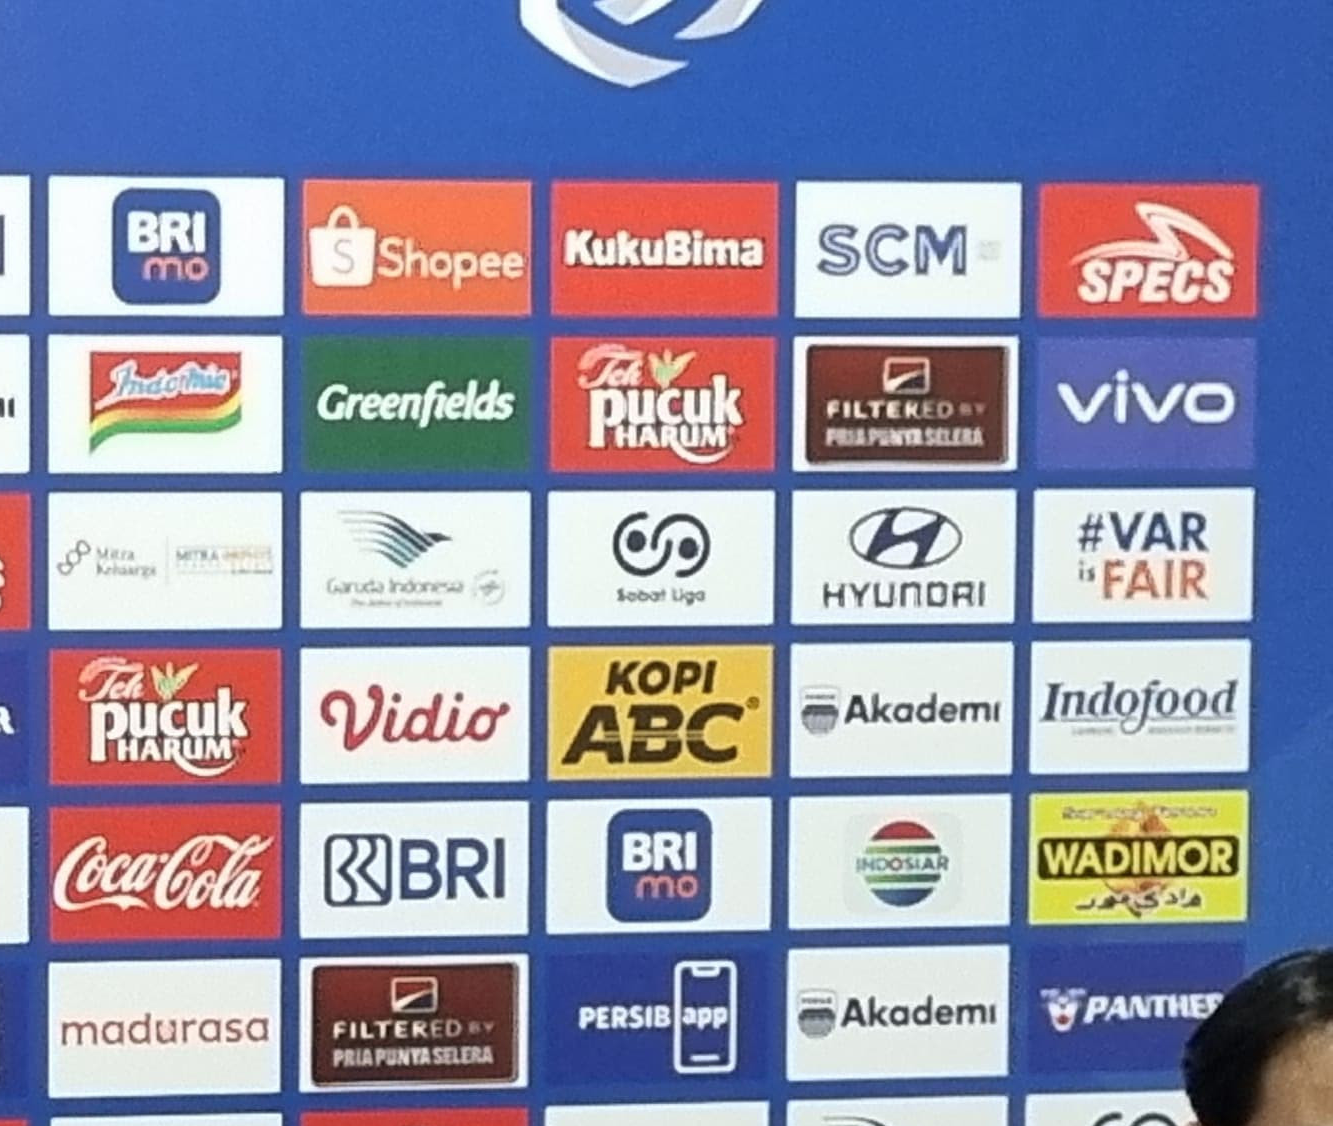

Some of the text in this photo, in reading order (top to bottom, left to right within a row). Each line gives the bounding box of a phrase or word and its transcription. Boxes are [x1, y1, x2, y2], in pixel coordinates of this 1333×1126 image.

[128, 211, 206, 252] BRI
[564, 229, 763, 268] KukuBima
[819, 225, 967, 276] SCM
[143, 257, 208, 281] mo
[376, 236, 522, 290] Shopee
[1079, 260, 1234, 303] SPECS
[317, 380, 515, 429] Greenfields
[589, 376, 742, 448] pucuk
[1058, 371, 1235, 424] vivo
[617, 426, 728, 448] HARUM
[1078, 512, 1208, 550] #VAR
[1102, 560, 1208, 598] FAIR
[79, 656, 145, 702] Teh
[605, 661, 716, 696] KOPI
[89, 688, 248, 762] pucuk
[320, 685, 510, 750] Vidio
[844, 693, 1001, 725] Akademi
[1040, 680, 1236, 734] Indofood
[117, 740, 231, 762] HARUM
[562, 702, 745, 765] ABC
[401, 837, 505, 899] BRI
[622, 832, 696, 871] BRI
[1042, 840, 1233, 875] WADIMOR
[53, 834, 272, 911] Coca-Cola
[637, 875, 697, 899] mo
[61, 1013, 269, 1046] madurasa
[333, 1019, 461, 1040] FILTERED
[579, 1005, 728, 1031] PERSIB app
[841, 996, 997, 1028] Akademi
